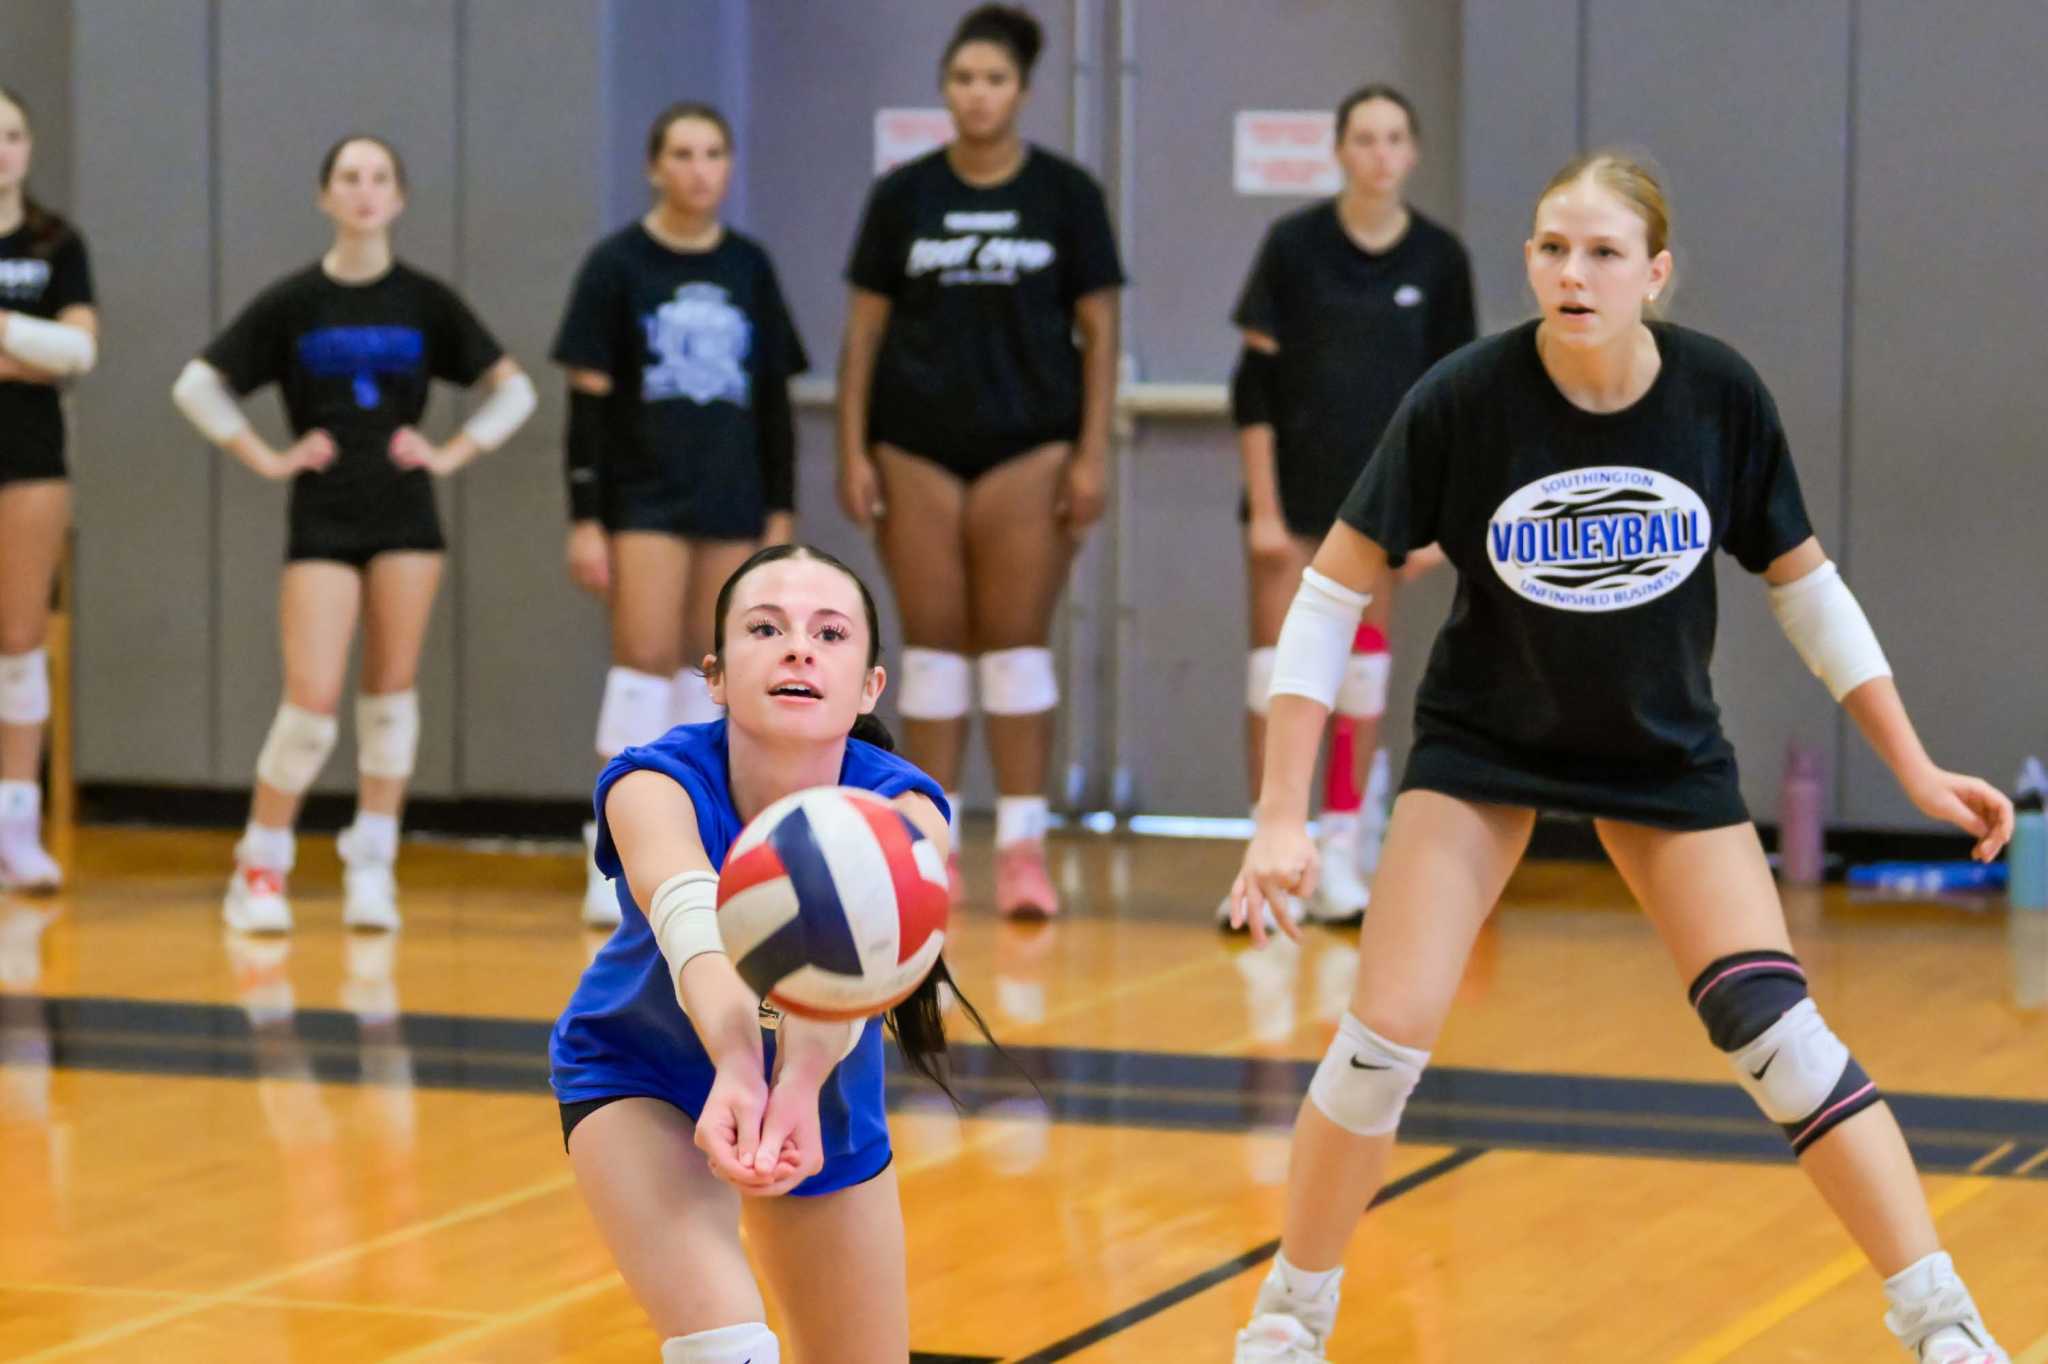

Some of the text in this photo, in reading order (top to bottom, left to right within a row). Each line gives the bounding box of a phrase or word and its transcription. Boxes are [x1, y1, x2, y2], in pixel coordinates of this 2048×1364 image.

[1541, 471, 1655, 493] SOUTHINGTON
[1491, 510, 1704, 562] VOLLEYBALL
[1520, 570, 1680, 606] UNFINISHED BUSINESS
